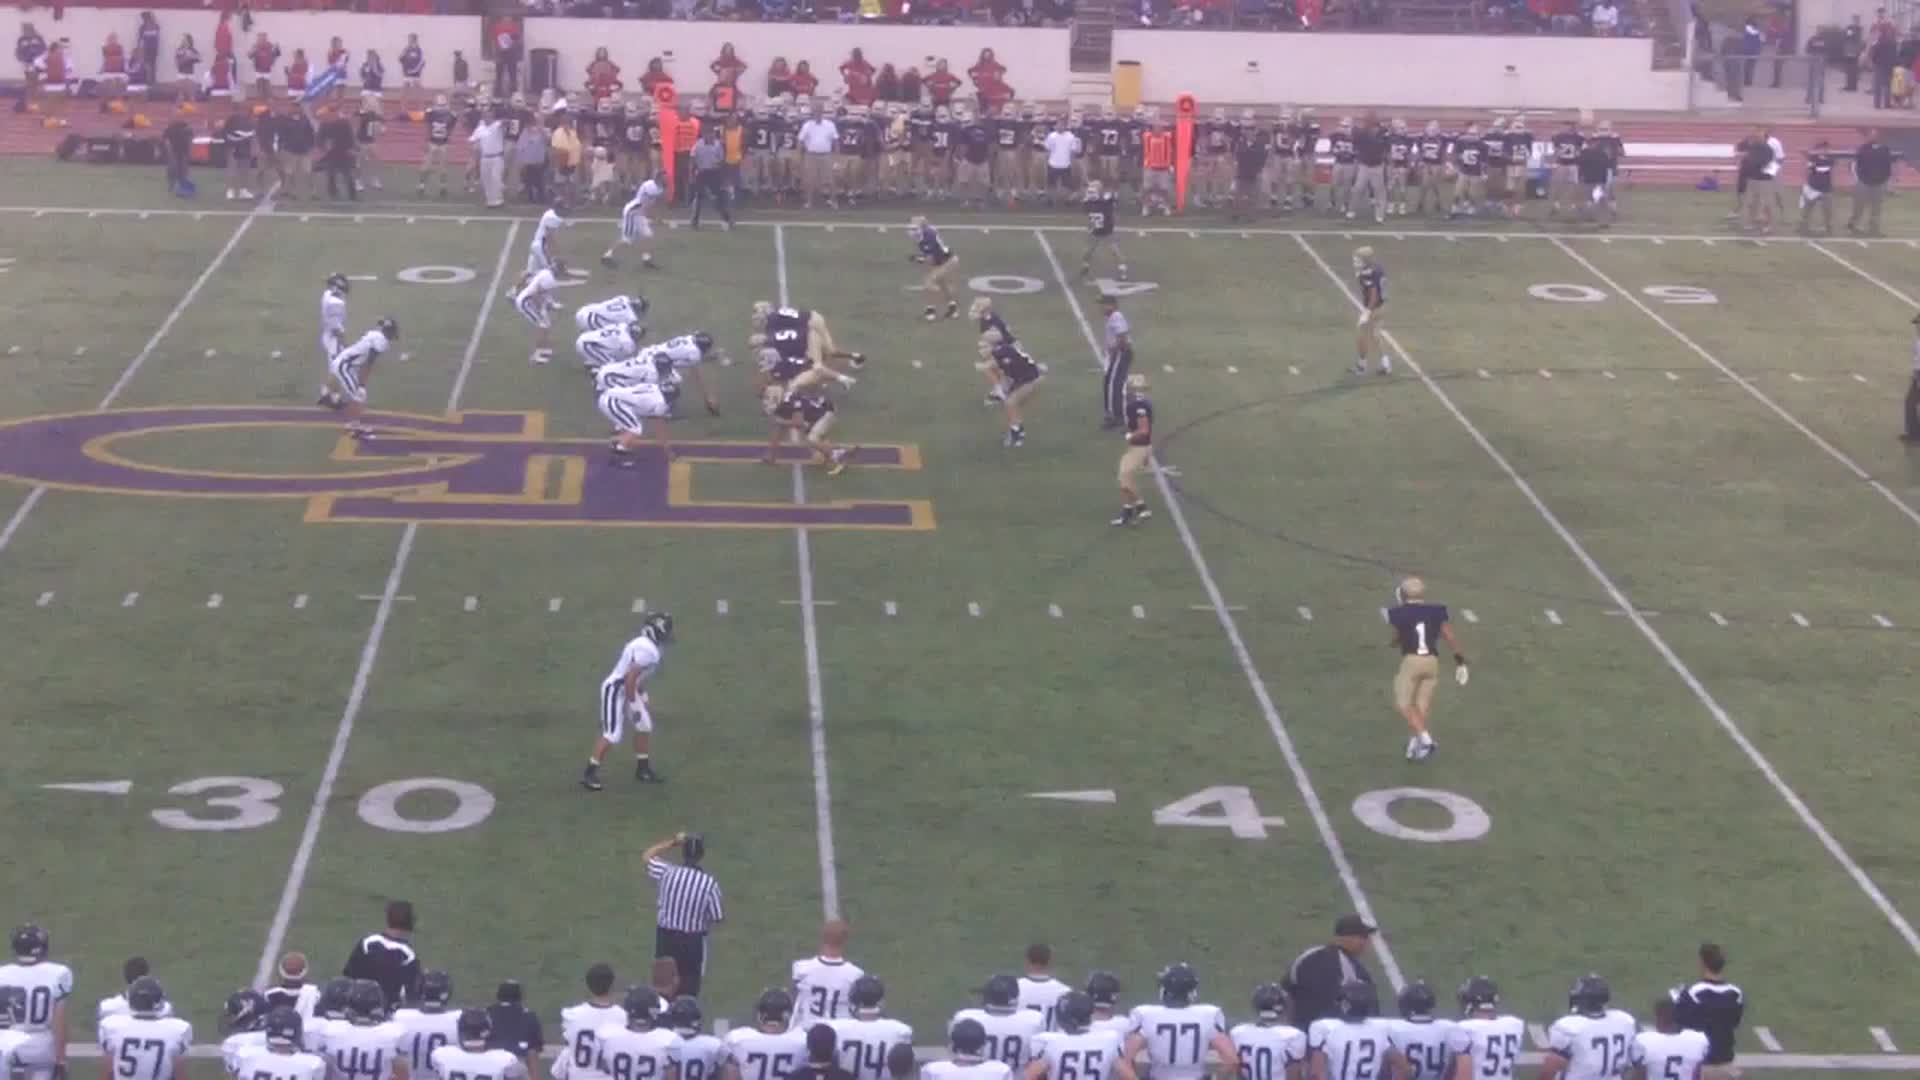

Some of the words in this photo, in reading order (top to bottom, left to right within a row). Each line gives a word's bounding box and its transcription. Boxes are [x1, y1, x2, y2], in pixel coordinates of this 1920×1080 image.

[1415, 621, 1430, 655] 1
[151, 776, 497, 832] 30
[1152, 785, 1492, 842] 40
[809, 986, 841, 1017] 31
[117, 1037, 166, 1080] 57
[337, 1047, 383, 1075] 44
[842, 1039, 887, 1080] 74
[1156, 1022, 1200, 1064] 77
[1341, 1038, 1376, 1080] 12
[1405, 1042, 1445, 1080] 54
[1482, 1034, 1517, 1076] 55
[1591, 1033, 1625, 1079] 72
[613, 1052, 656, 1080] 82
[747, 1052, 793, 1080] 75
[1058, 1049, 1103, 1080] 65
[1664, 1055, 1683, 1080] 5
